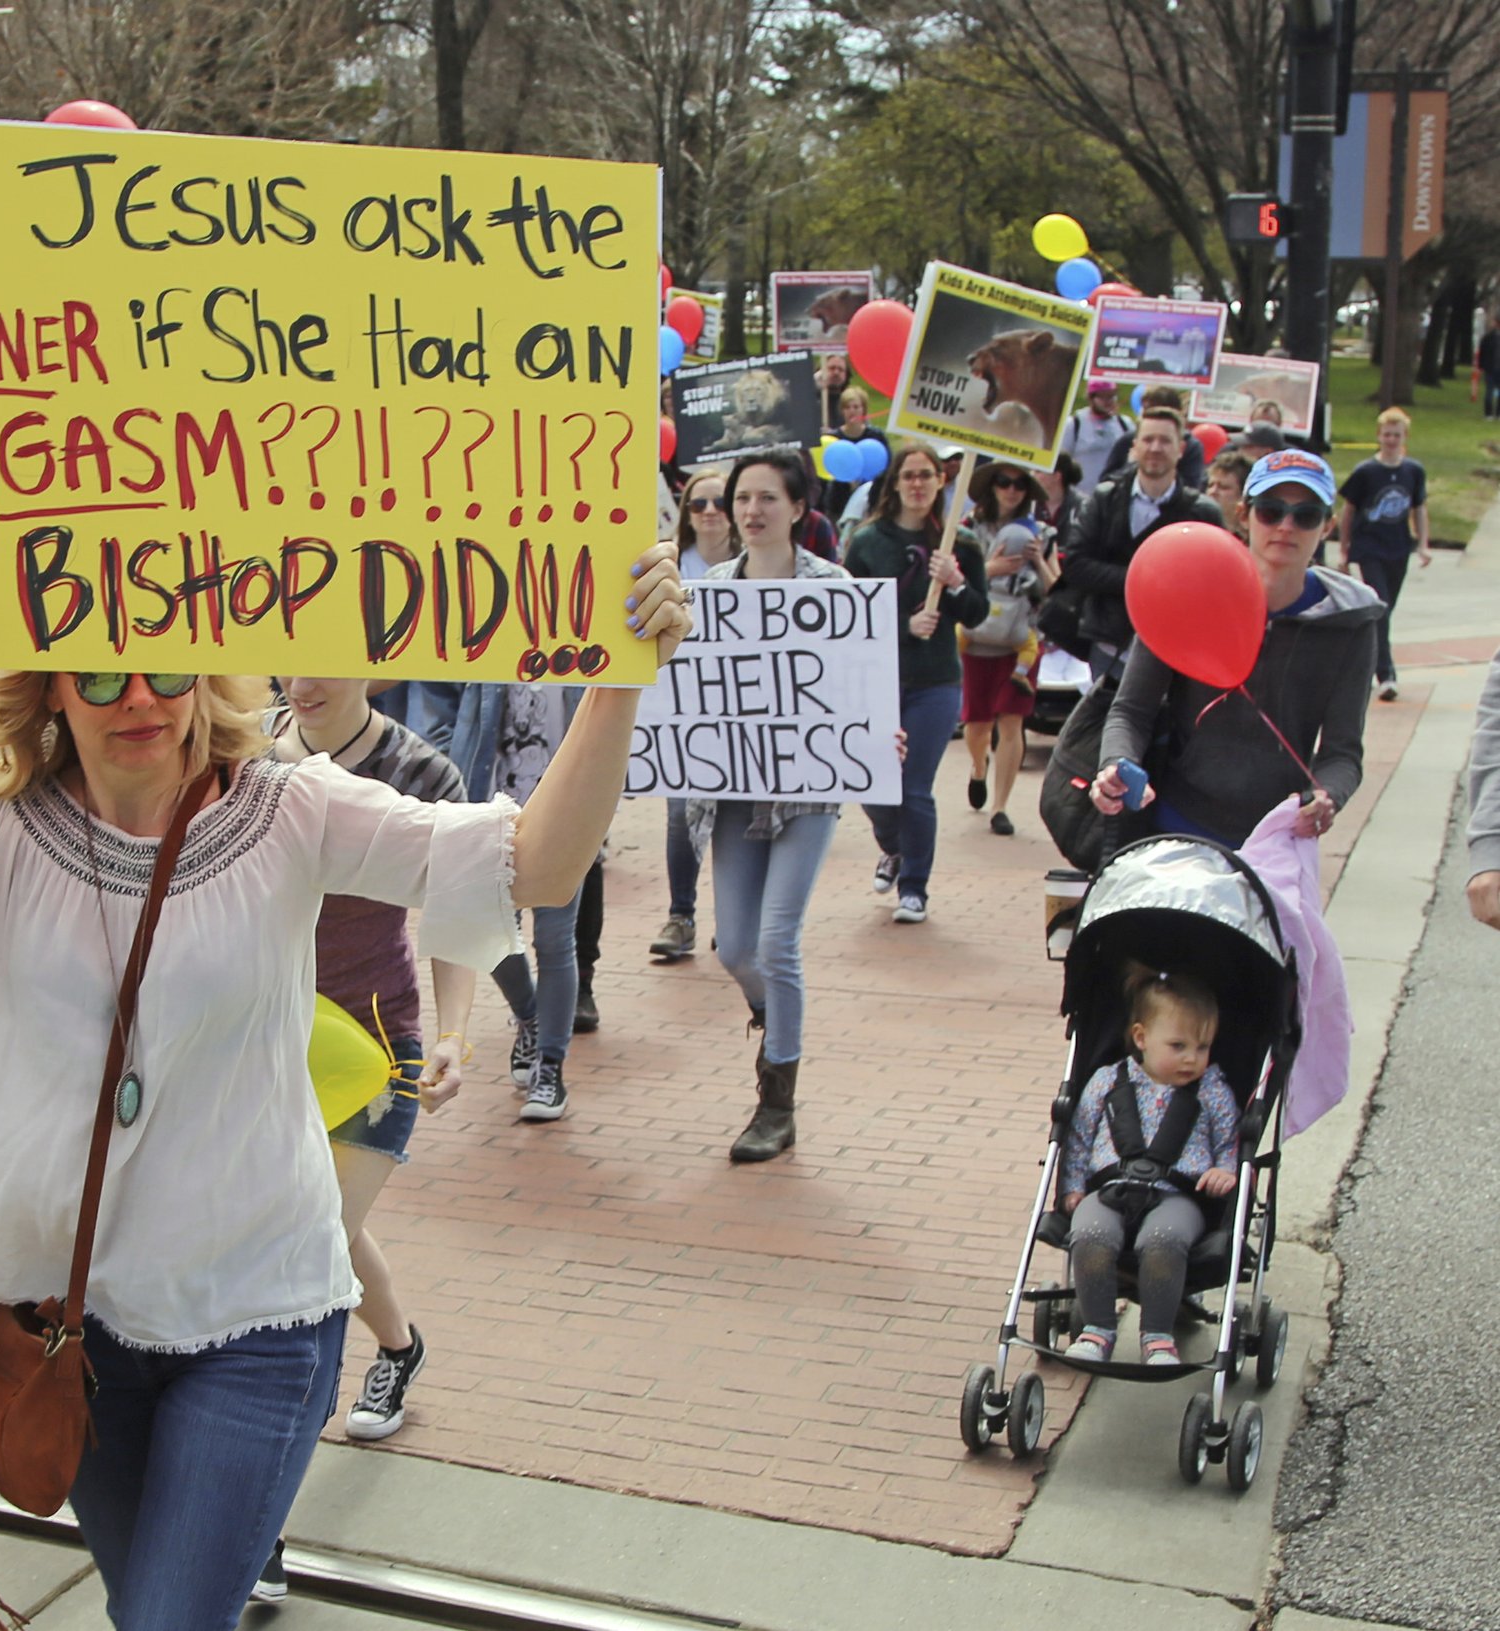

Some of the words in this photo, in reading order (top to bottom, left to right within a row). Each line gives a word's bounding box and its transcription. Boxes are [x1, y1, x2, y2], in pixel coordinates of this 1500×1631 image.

[1412, 113, 1436, 232] DOWNTOWN
[342, 173, 486, 266] ask
[486, 176, 627, 279] the
[938, 271, 963, 290] Kids
[964, 279, 986, 296] Are
[128, 287, 192, 370] if
[201, 285, 336, 384] She
[361, 292, 489, 389] Had
[683, 386, 711, 402] STOP
[909, 386, 967, 417] -NOW-
[919, 365, 955, 388] STOP
[955, 375, 970, 392] IT
[16, 525, 339, 656] BISHOP
[757, 581, 887, 642] BODY
[666, 648, 836, 718] THEIR
[622, 716, 874, 796] BUSINESS
